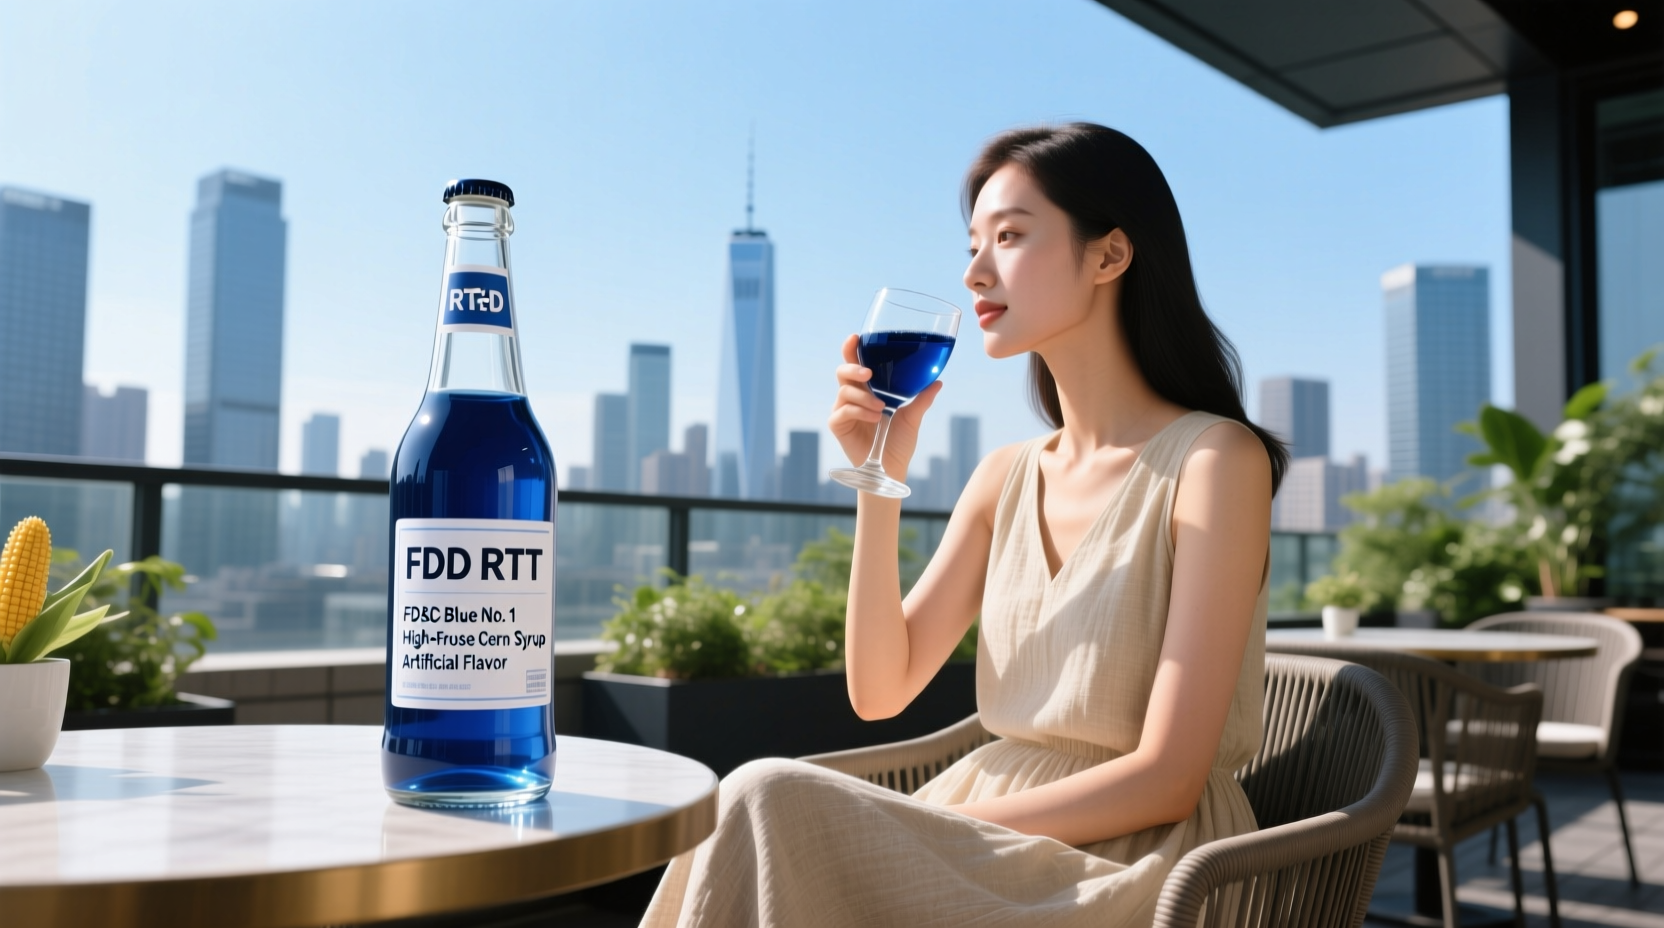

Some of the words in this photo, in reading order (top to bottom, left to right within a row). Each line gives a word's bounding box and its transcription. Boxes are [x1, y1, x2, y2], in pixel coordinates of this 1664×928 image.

[406, 546, 472, 580] FDD
[480, 547, 543, 581] RTT
[444, 606, 478, 623] Blue
[481, 606, 506, 623] No.
[509, 606, 516, 623] 1
[514, 630, 546, 651] Syrup
[402, 653, 459, 670] Artificial
[463, 654, 508, 670] Flavor
